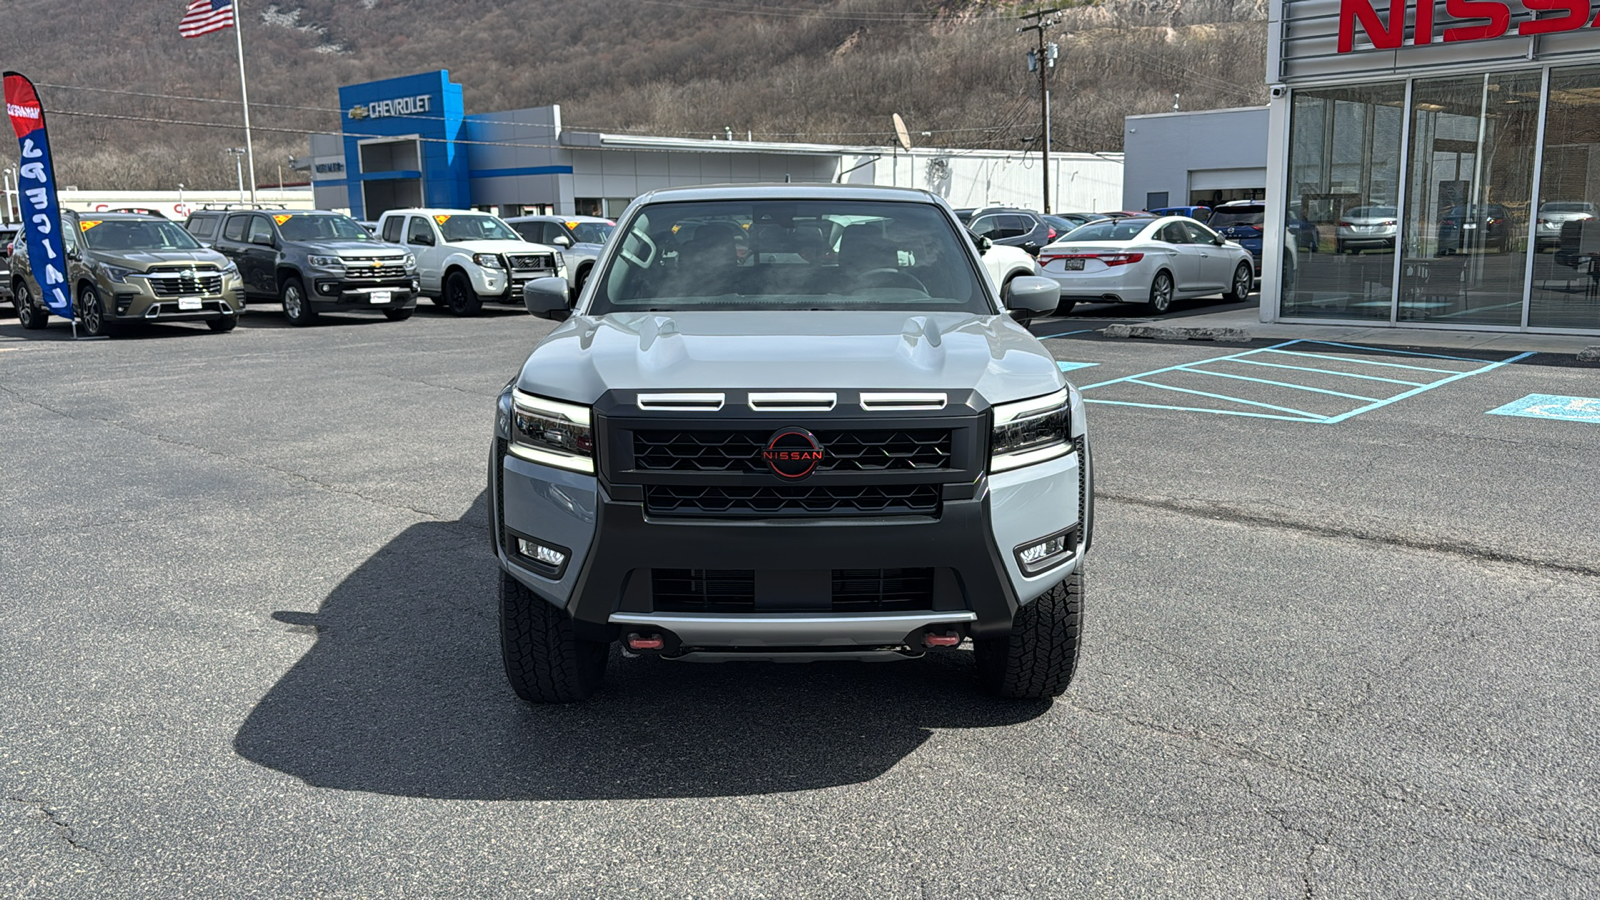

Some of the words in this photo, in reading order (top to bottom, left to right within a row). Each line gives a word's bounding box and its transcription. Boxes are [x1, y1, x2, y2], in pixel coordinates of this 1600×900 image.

[1337, 0, 1600, 53] NISS
[369, 95, 431, 118] CHEVROLET
[763, 452, 822, 460] NISSAN
